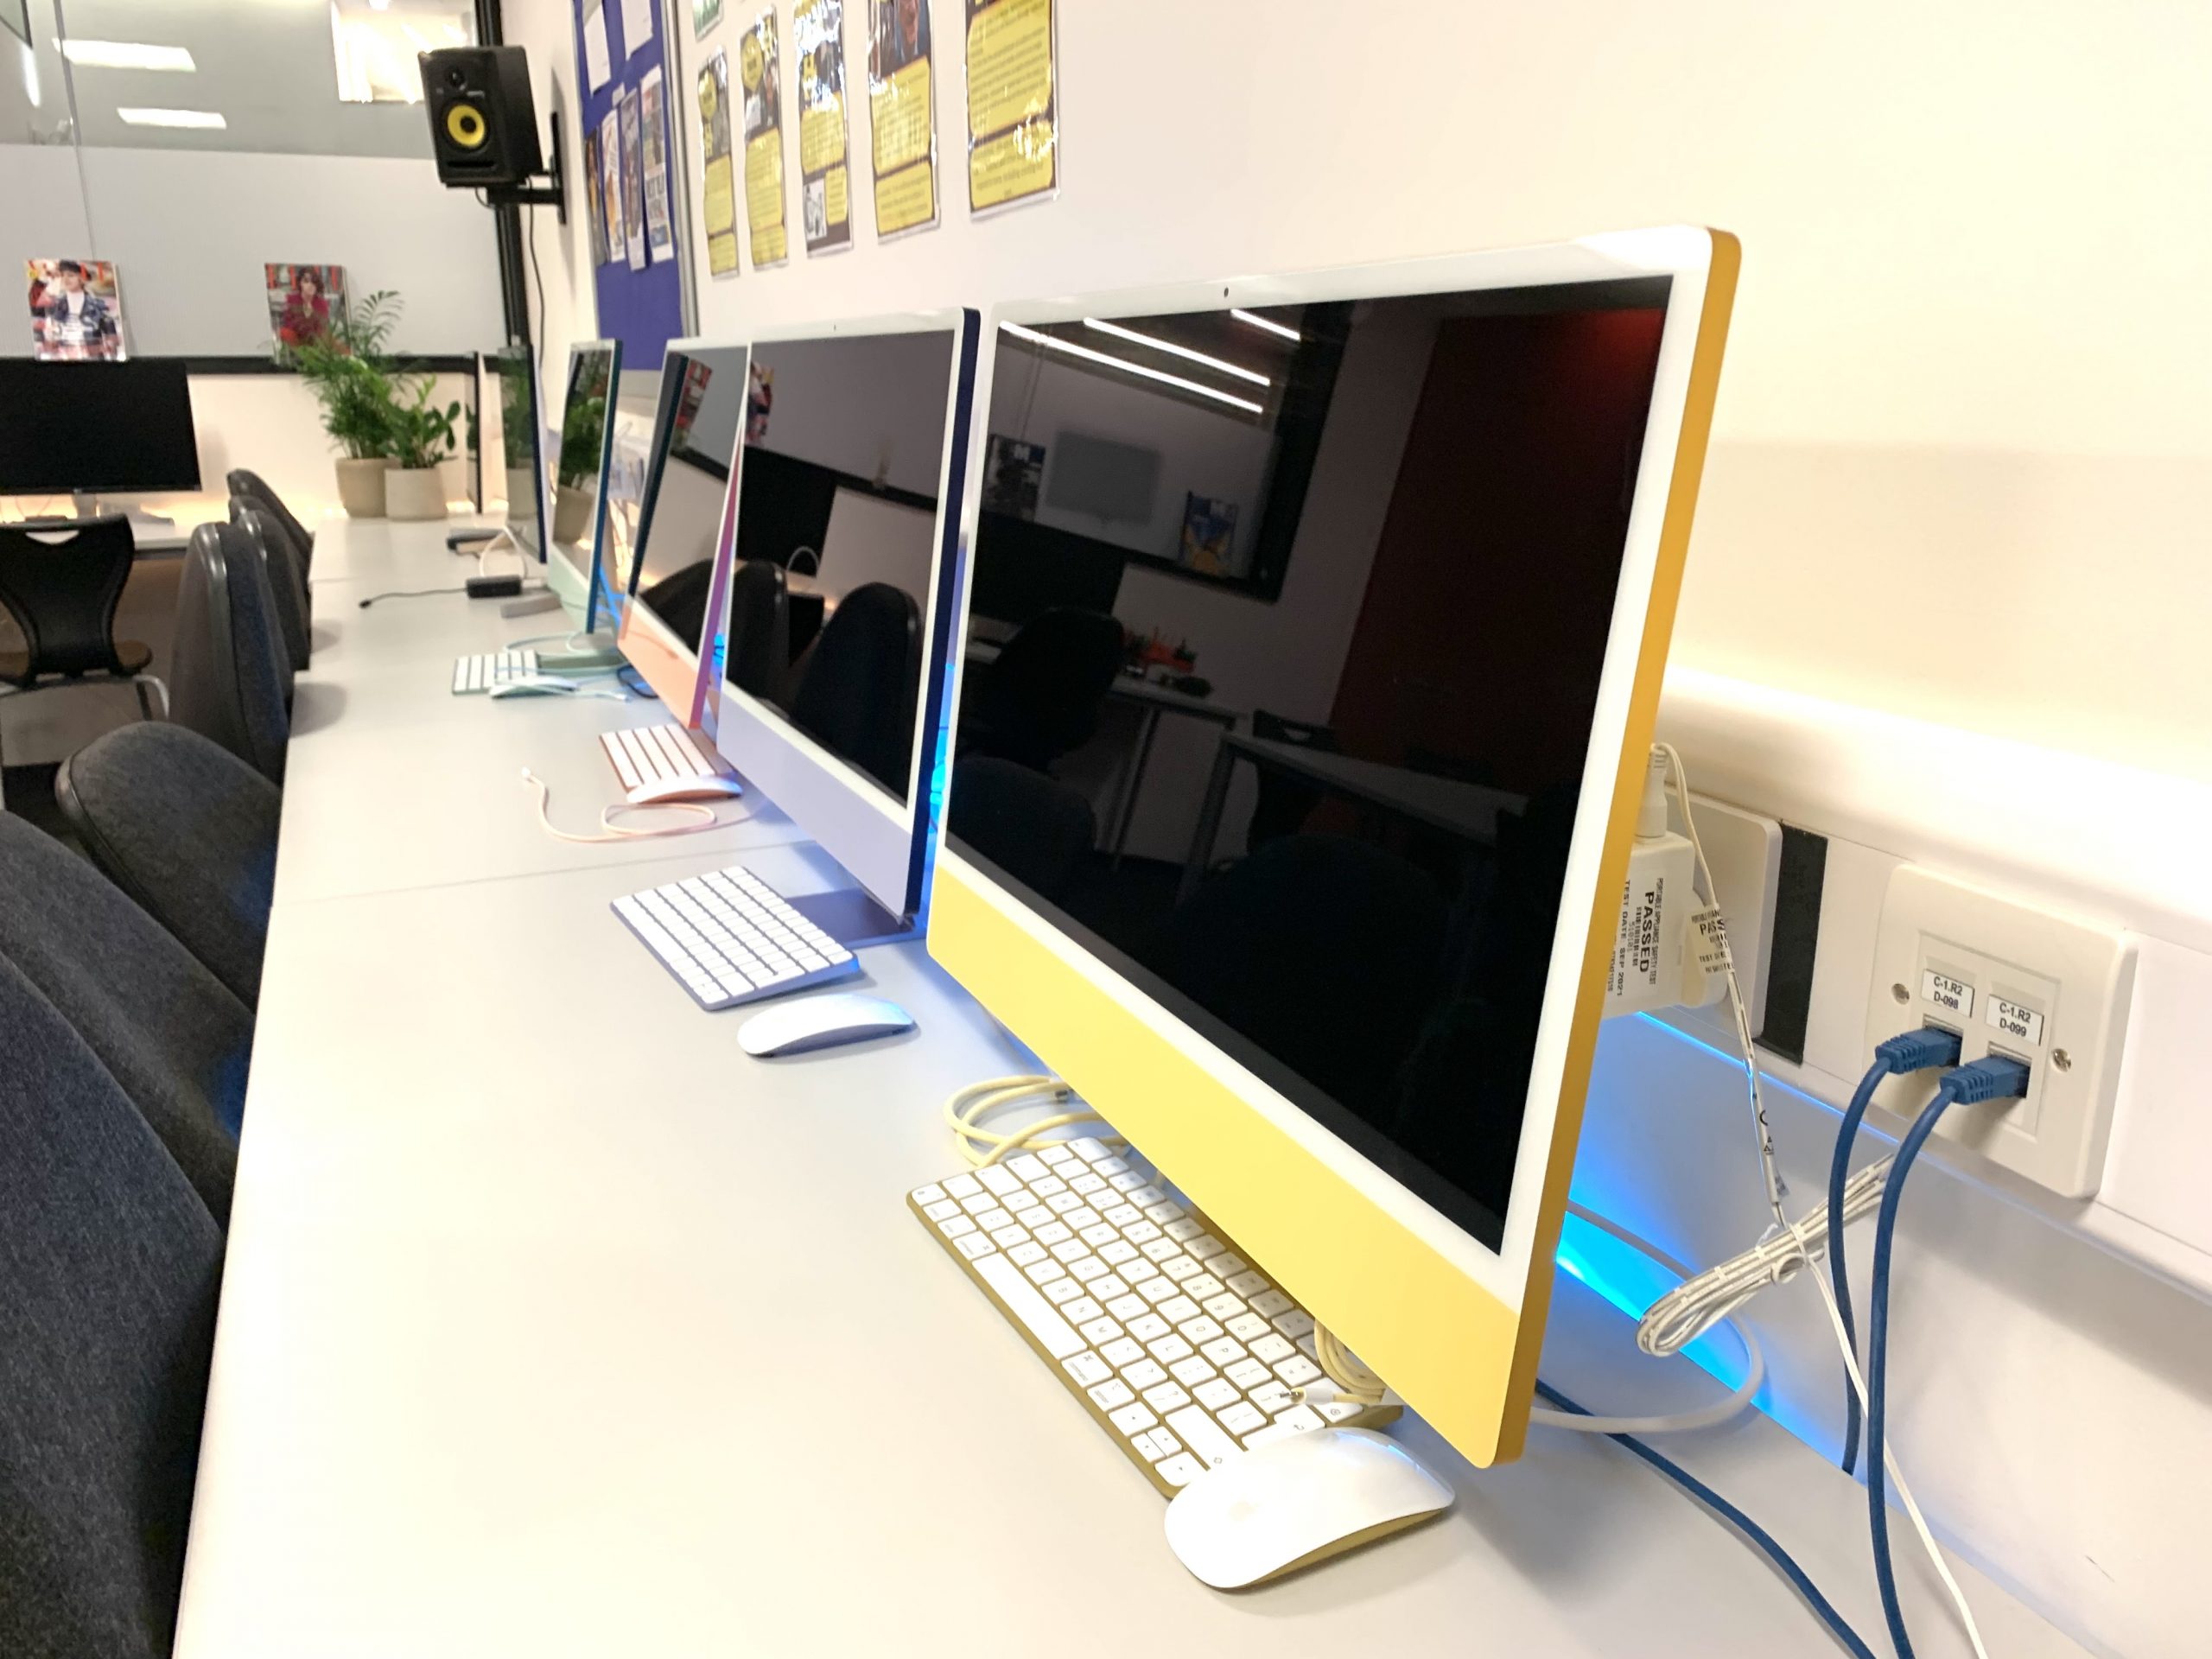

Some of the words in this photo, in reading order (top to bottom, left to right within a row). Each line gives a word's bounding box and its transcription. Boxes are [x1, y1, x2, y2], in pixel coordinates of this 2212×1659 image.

[1655, 878, 1664, 908] PORTABLE
[1640, 891, 1654, 972] PASSED
[1652, 911, 1661, 944] APPLIANCE
[1934, 976, 1962, 996] C-1.R2
[1934, 991, 1958, 1009] D-098
[1999, 1001, 2031, 1023] C-1.R2
[1999, 1018, 2026, 1037] D-099
